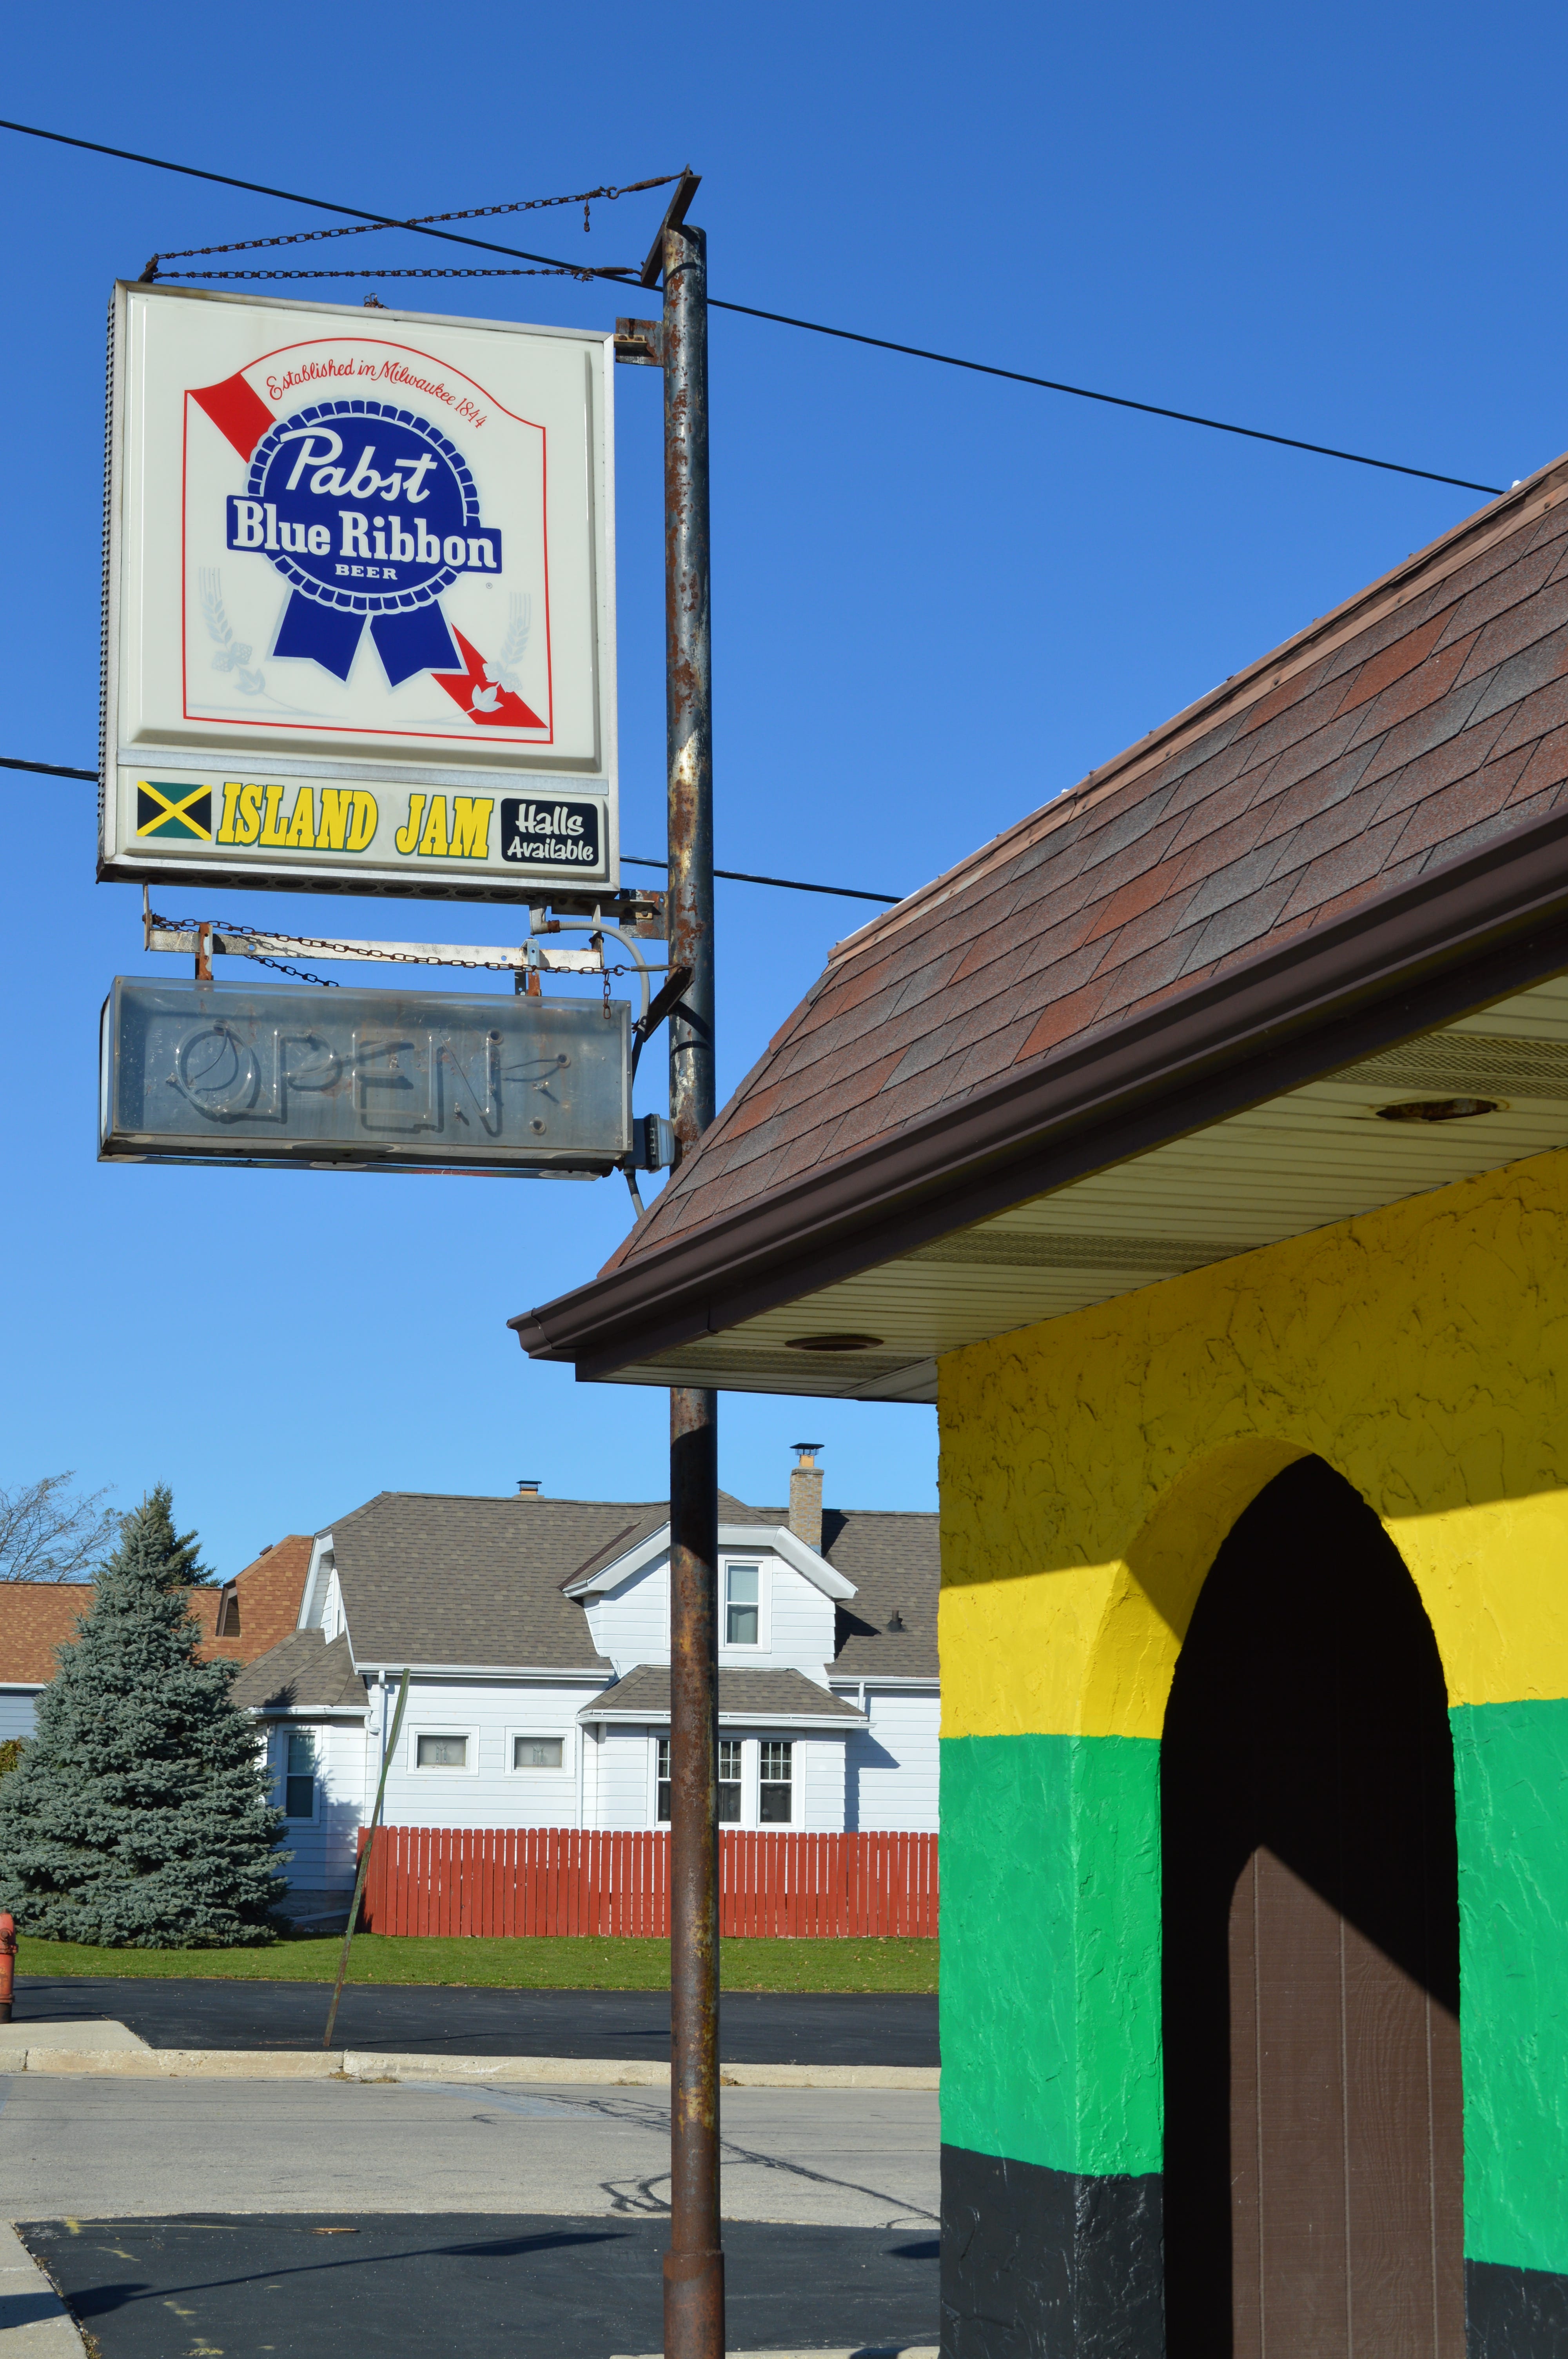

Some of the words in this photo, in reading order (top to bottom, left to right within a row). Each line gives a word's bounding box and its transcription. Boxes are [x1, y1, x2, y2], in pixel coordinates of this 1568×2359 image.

[267, 358, 355, 401] Established
[357, 359, 376, 376] in
[370, 360, 456, 405] Milwaukee
[454, 398, 488, 429] 1844
[279, 427, 438, 503] Pabst
[232, 499, 331, 556] Blue
[339, 511, 497, 569] Ribbon
[335, 564, 398, 580] BEER
[216, 782, 378, 852] ISLAND
[395, 793, 495, 859] JAM
[507, 837, 594, 861] Available
[515, 803, 583, 836] Halls
[174, 1023, 493, 1121] OPEN
